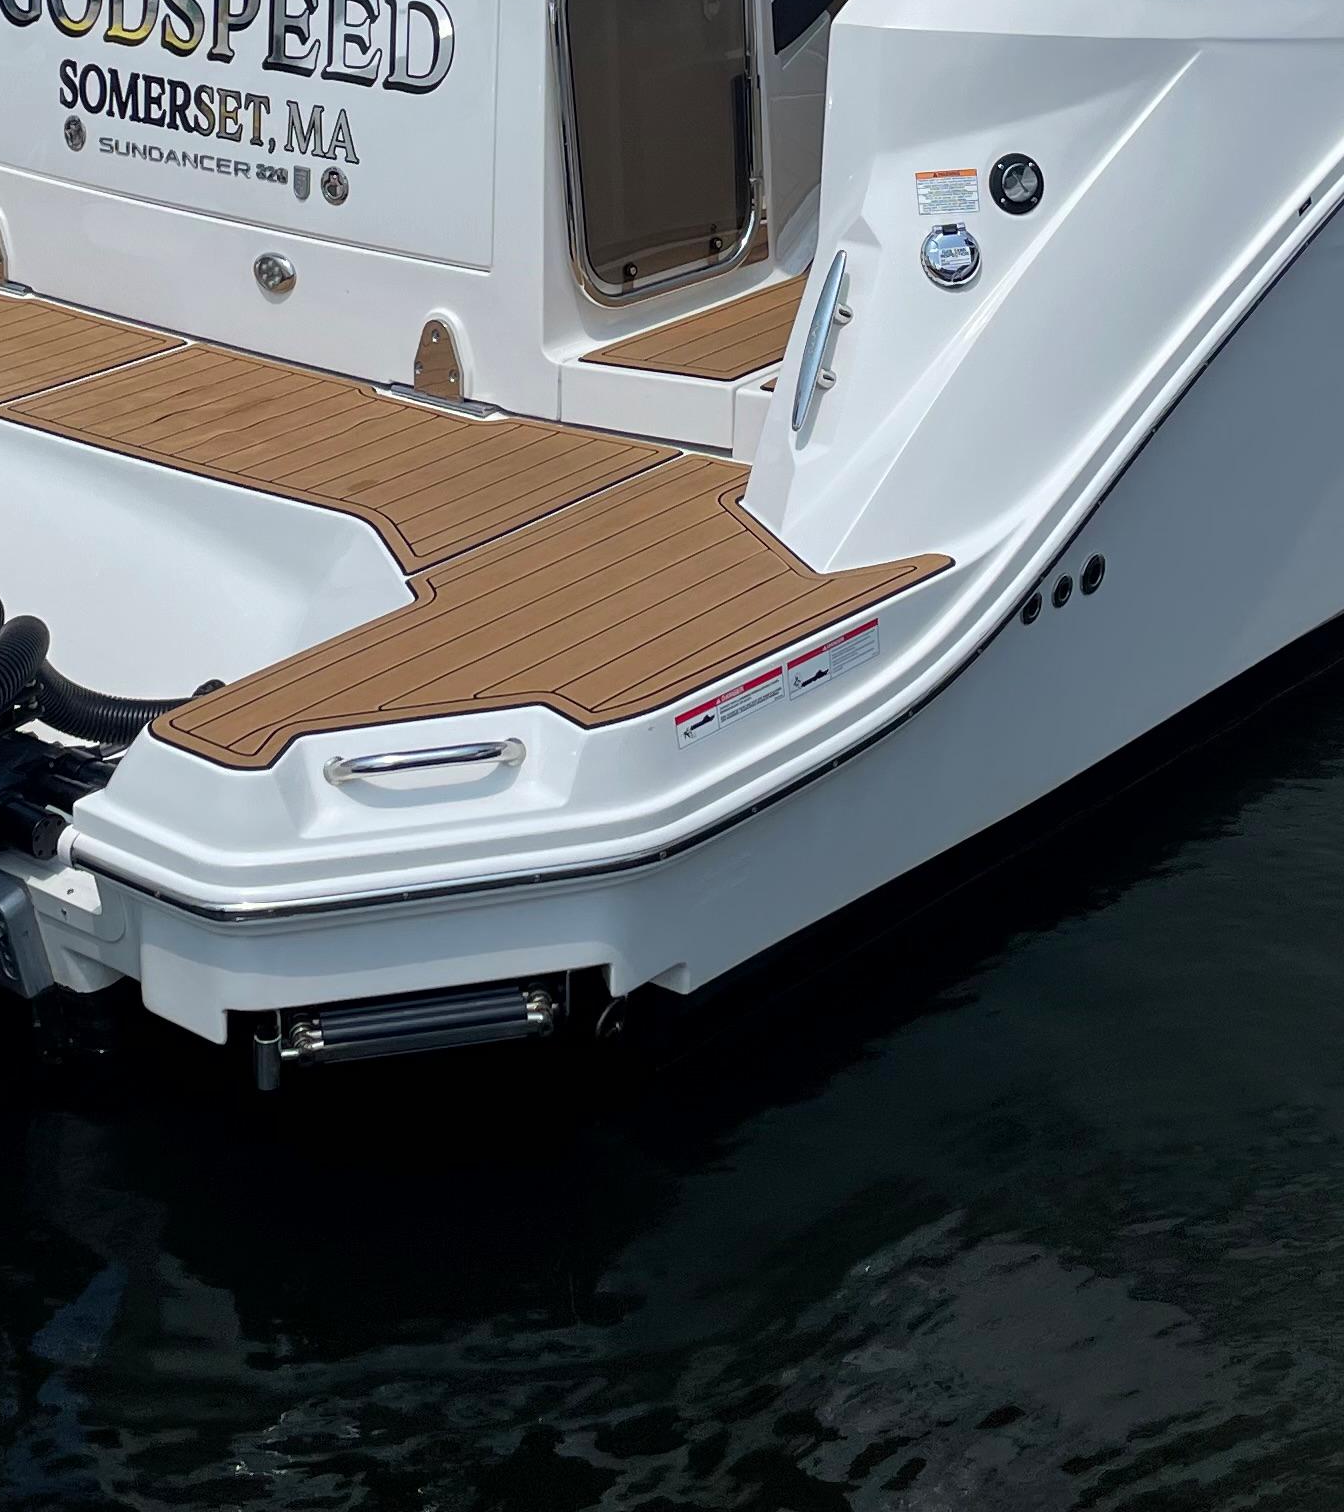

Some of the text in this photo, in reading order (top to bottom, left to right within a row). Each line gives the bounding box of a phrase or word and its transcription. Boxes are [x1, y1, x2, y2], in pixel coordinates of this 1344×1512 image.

[60, 59, 359, 164] SOMERSET, MA
[99, 137, 250, 178] SUNDANCER
